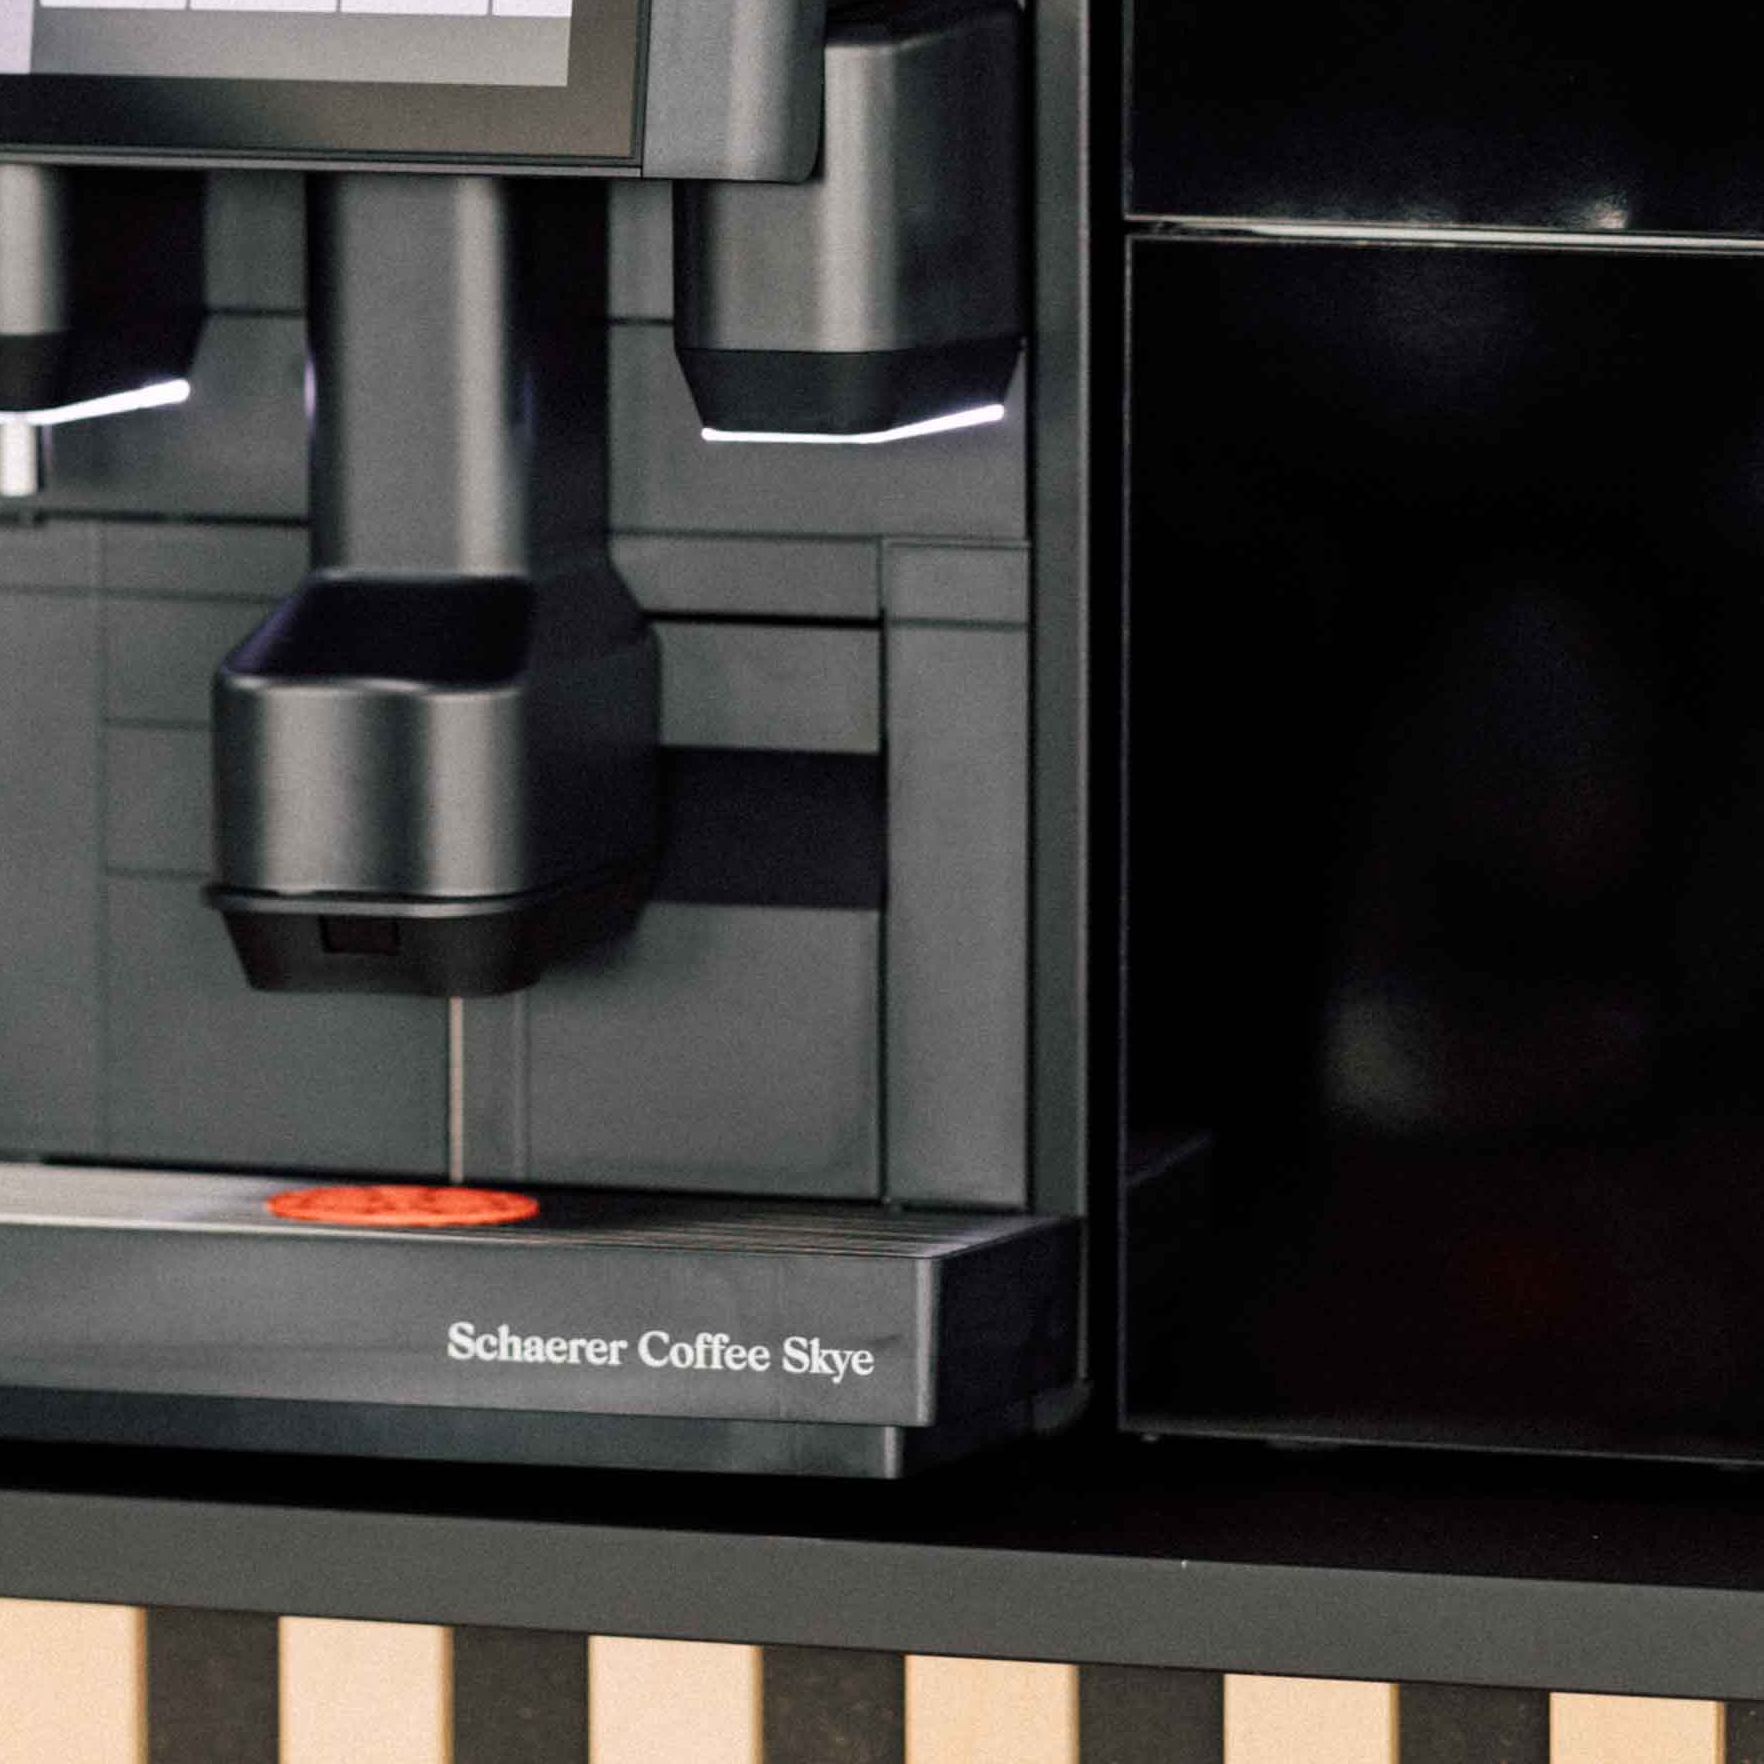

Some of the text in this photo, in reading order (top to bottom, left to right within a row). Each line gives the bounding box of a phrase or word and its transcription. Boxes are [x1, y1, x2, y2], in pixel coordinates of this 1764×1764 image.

[447, 1321, 875, 1384] Schaerer Coffee Skye
